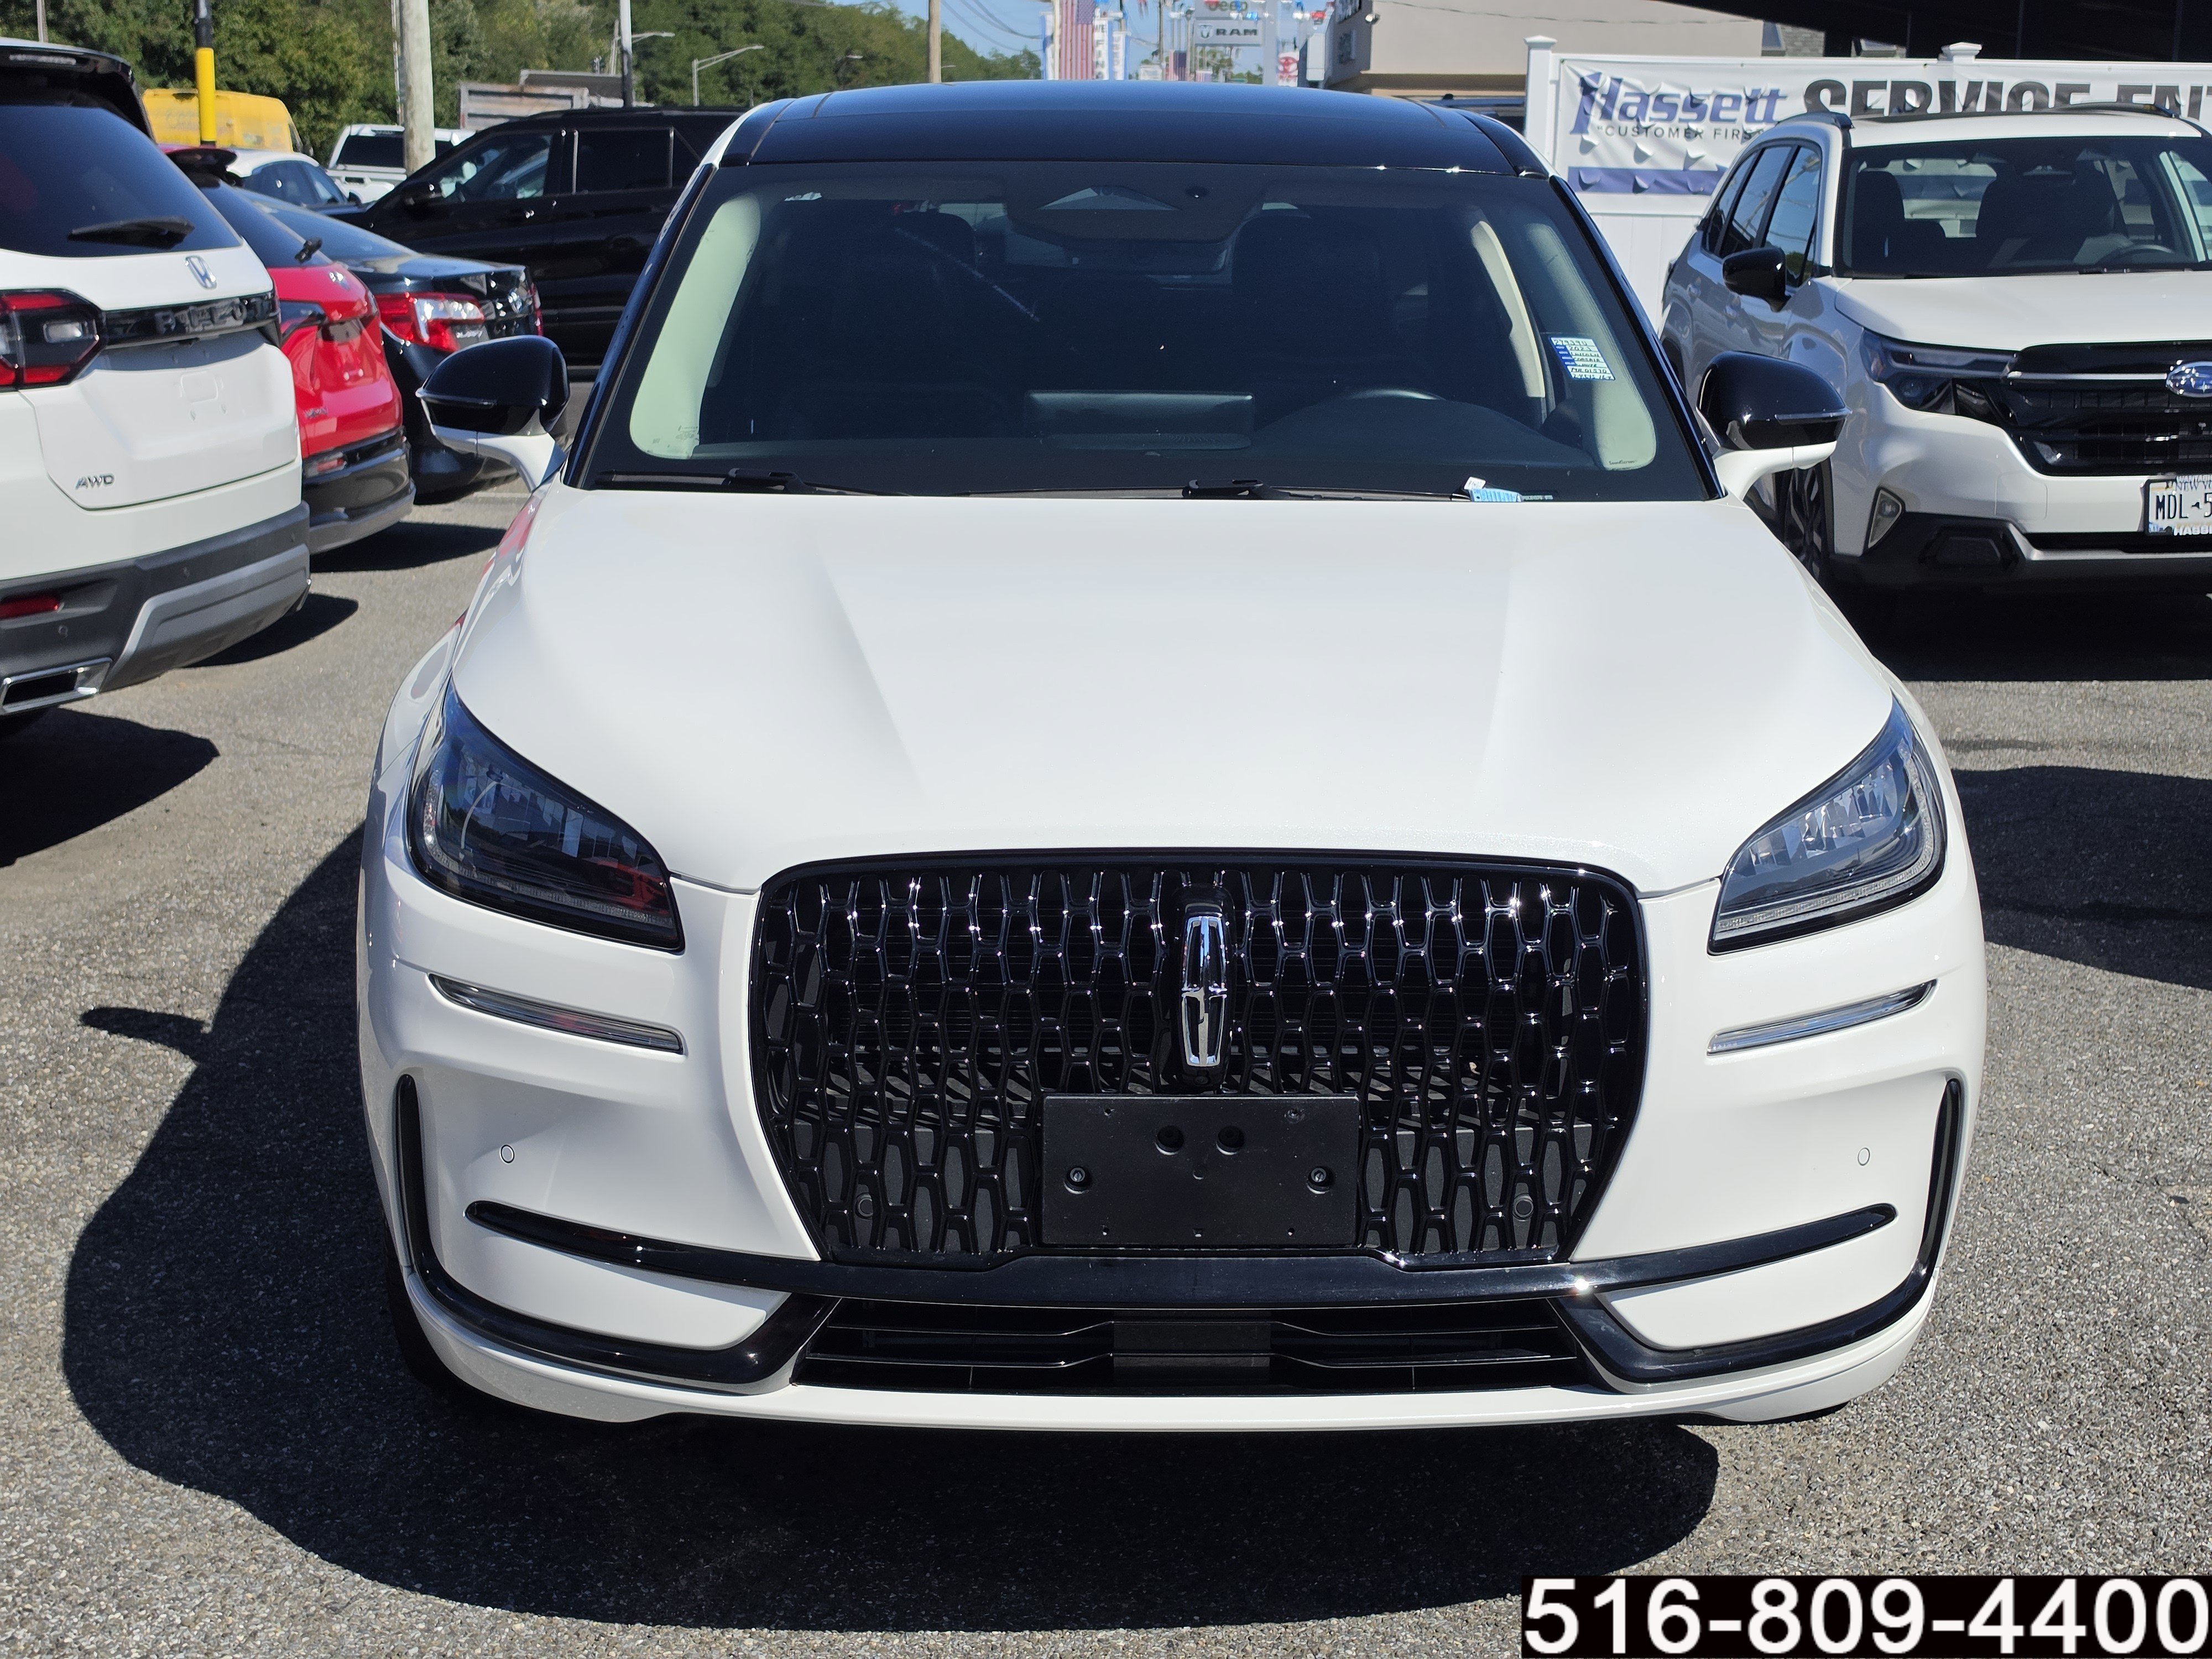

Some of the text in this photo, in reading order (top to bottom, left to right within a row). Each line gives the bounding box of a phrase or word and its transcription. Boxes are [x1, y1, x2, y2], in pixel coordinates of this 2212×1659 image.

[1569, 72, 1787, 134] Hassett
[75, 474, 114, 489] AWD
[2155, 493, 2189, 520] MDL
